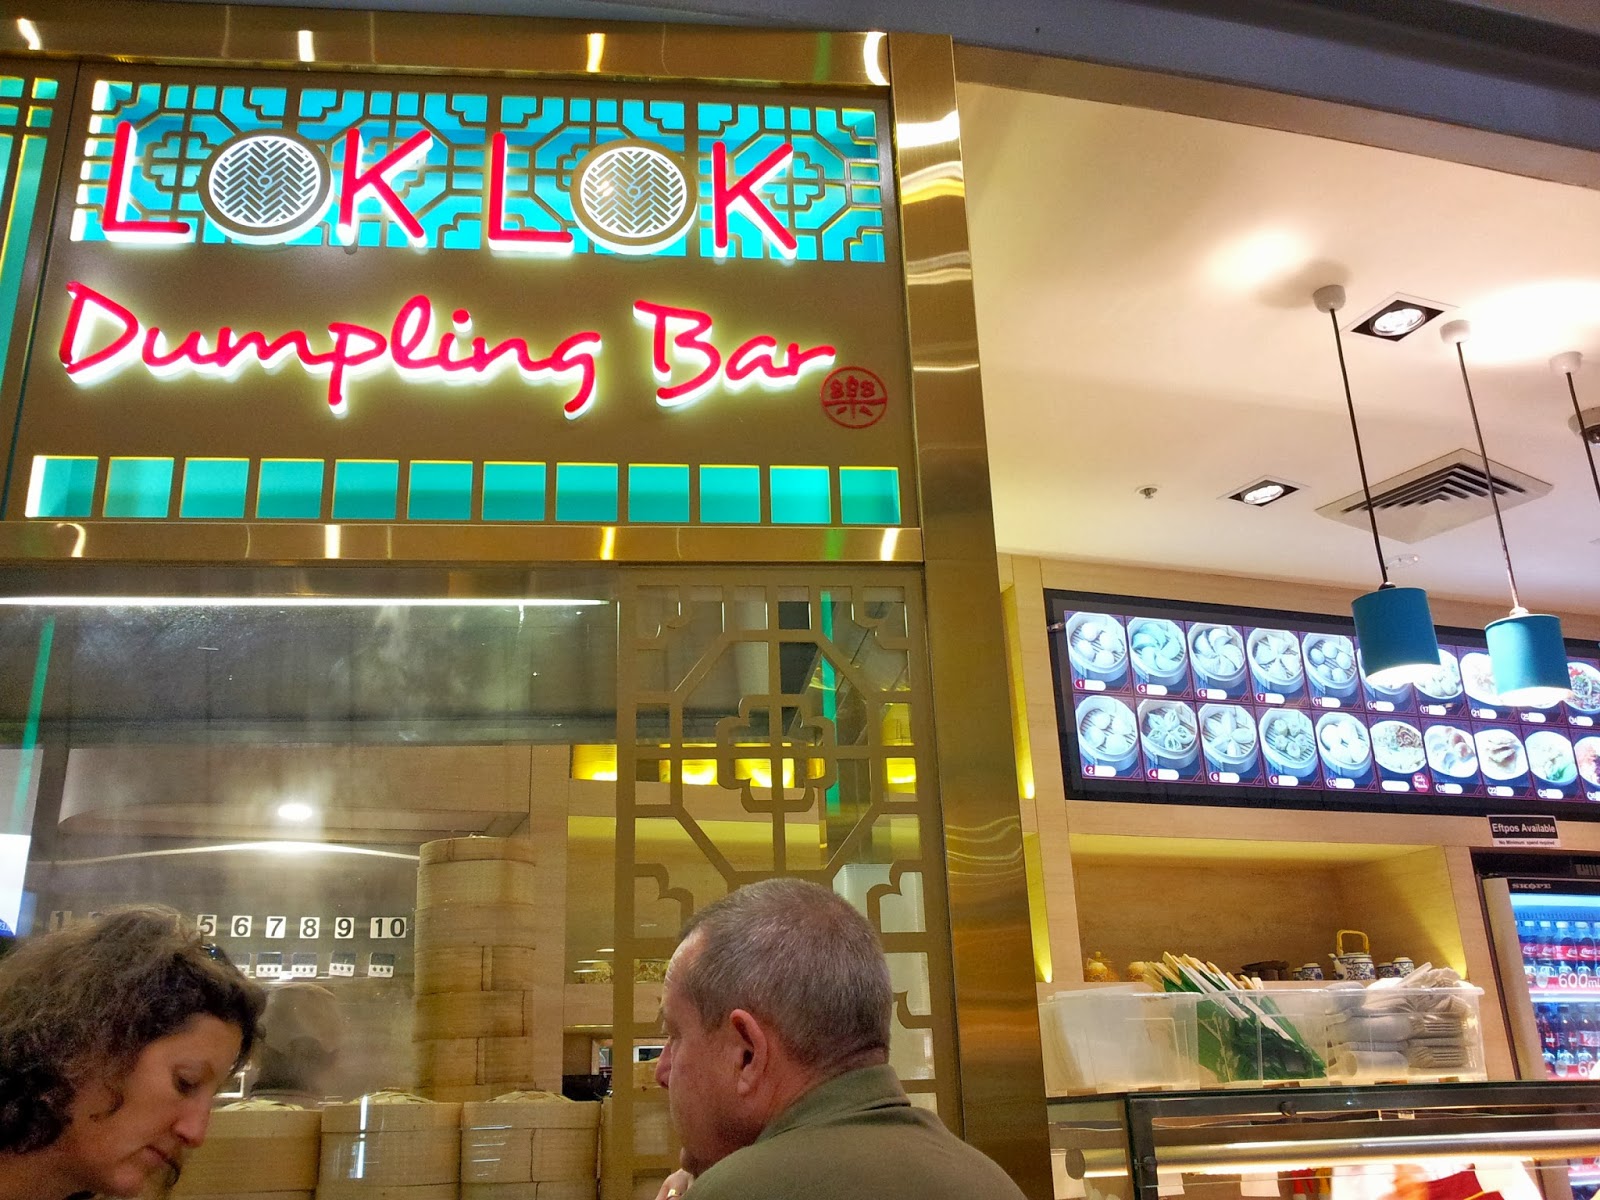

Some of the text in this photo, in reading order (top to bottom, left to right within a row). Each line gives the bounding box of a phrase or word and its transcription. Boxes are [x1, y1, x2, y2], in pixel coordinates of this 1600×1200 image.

[60, 280, 838, 420] Dumpling Bar
[1492, 823, 1556, 834] Eftpos Available
[199, 915, 214, 935] 5
[233, 917, 249, 936] 6
[270, 918, 284, 937] 7
[302, 918, 317, 937] 8
[337, 918, 351, 937] 9
[375, 918, 405, 937] 10
